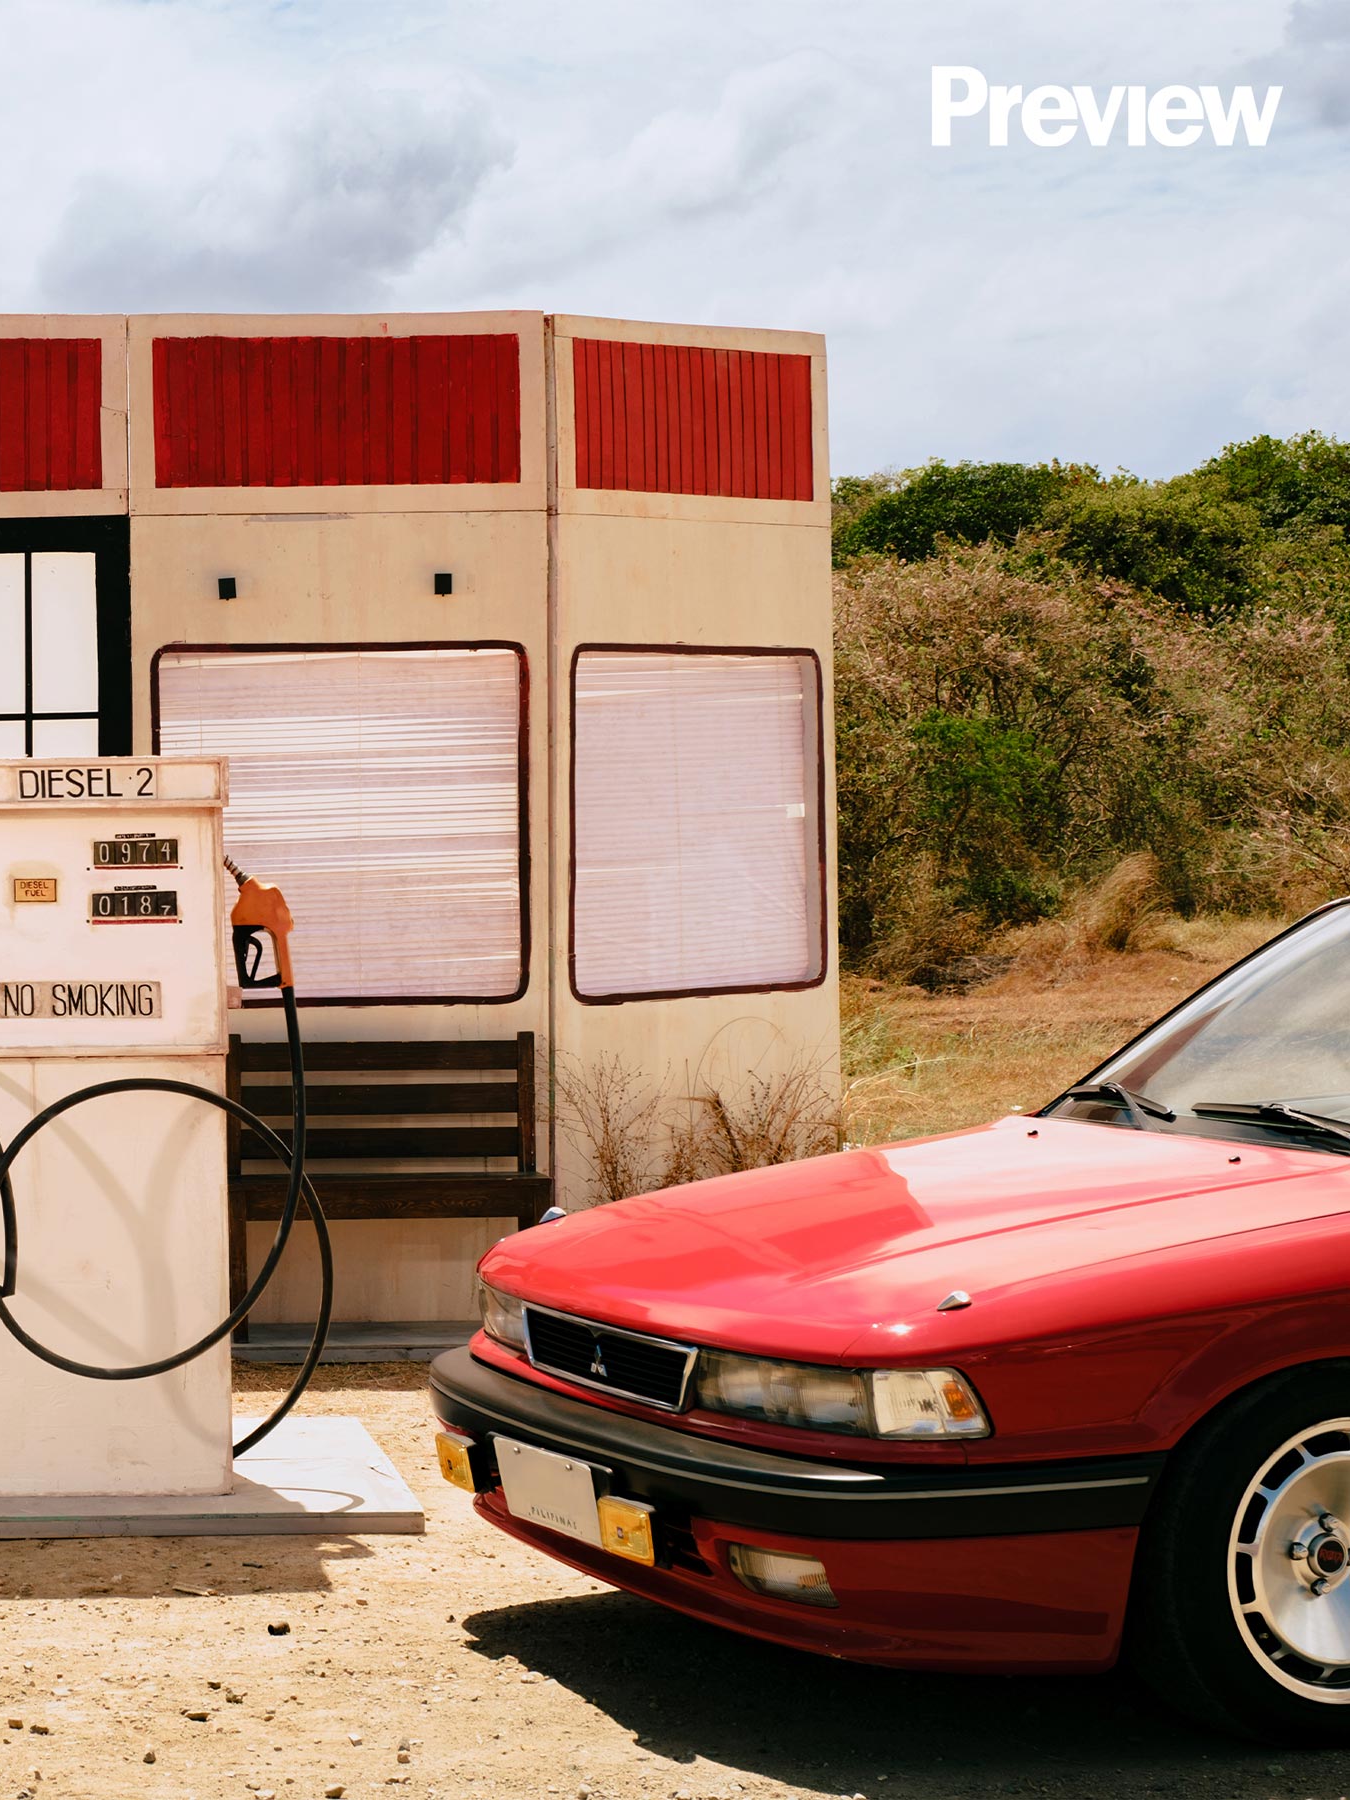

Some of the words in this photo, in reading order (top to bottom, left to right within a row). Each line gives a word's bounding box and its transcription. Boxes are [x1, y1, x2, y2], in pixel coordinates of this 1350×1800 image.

[18, 767, 123, 799] DIESEL
[136, 767, 154, 797] 2
[99, 842, 171, 864] 0974
[20, 880, 49, 890] DIESEL
[25, 889, 47, 897] FUEL
[4, 983, 35, 1016] NO
[51, 983, 154, 1016] SMOKING
